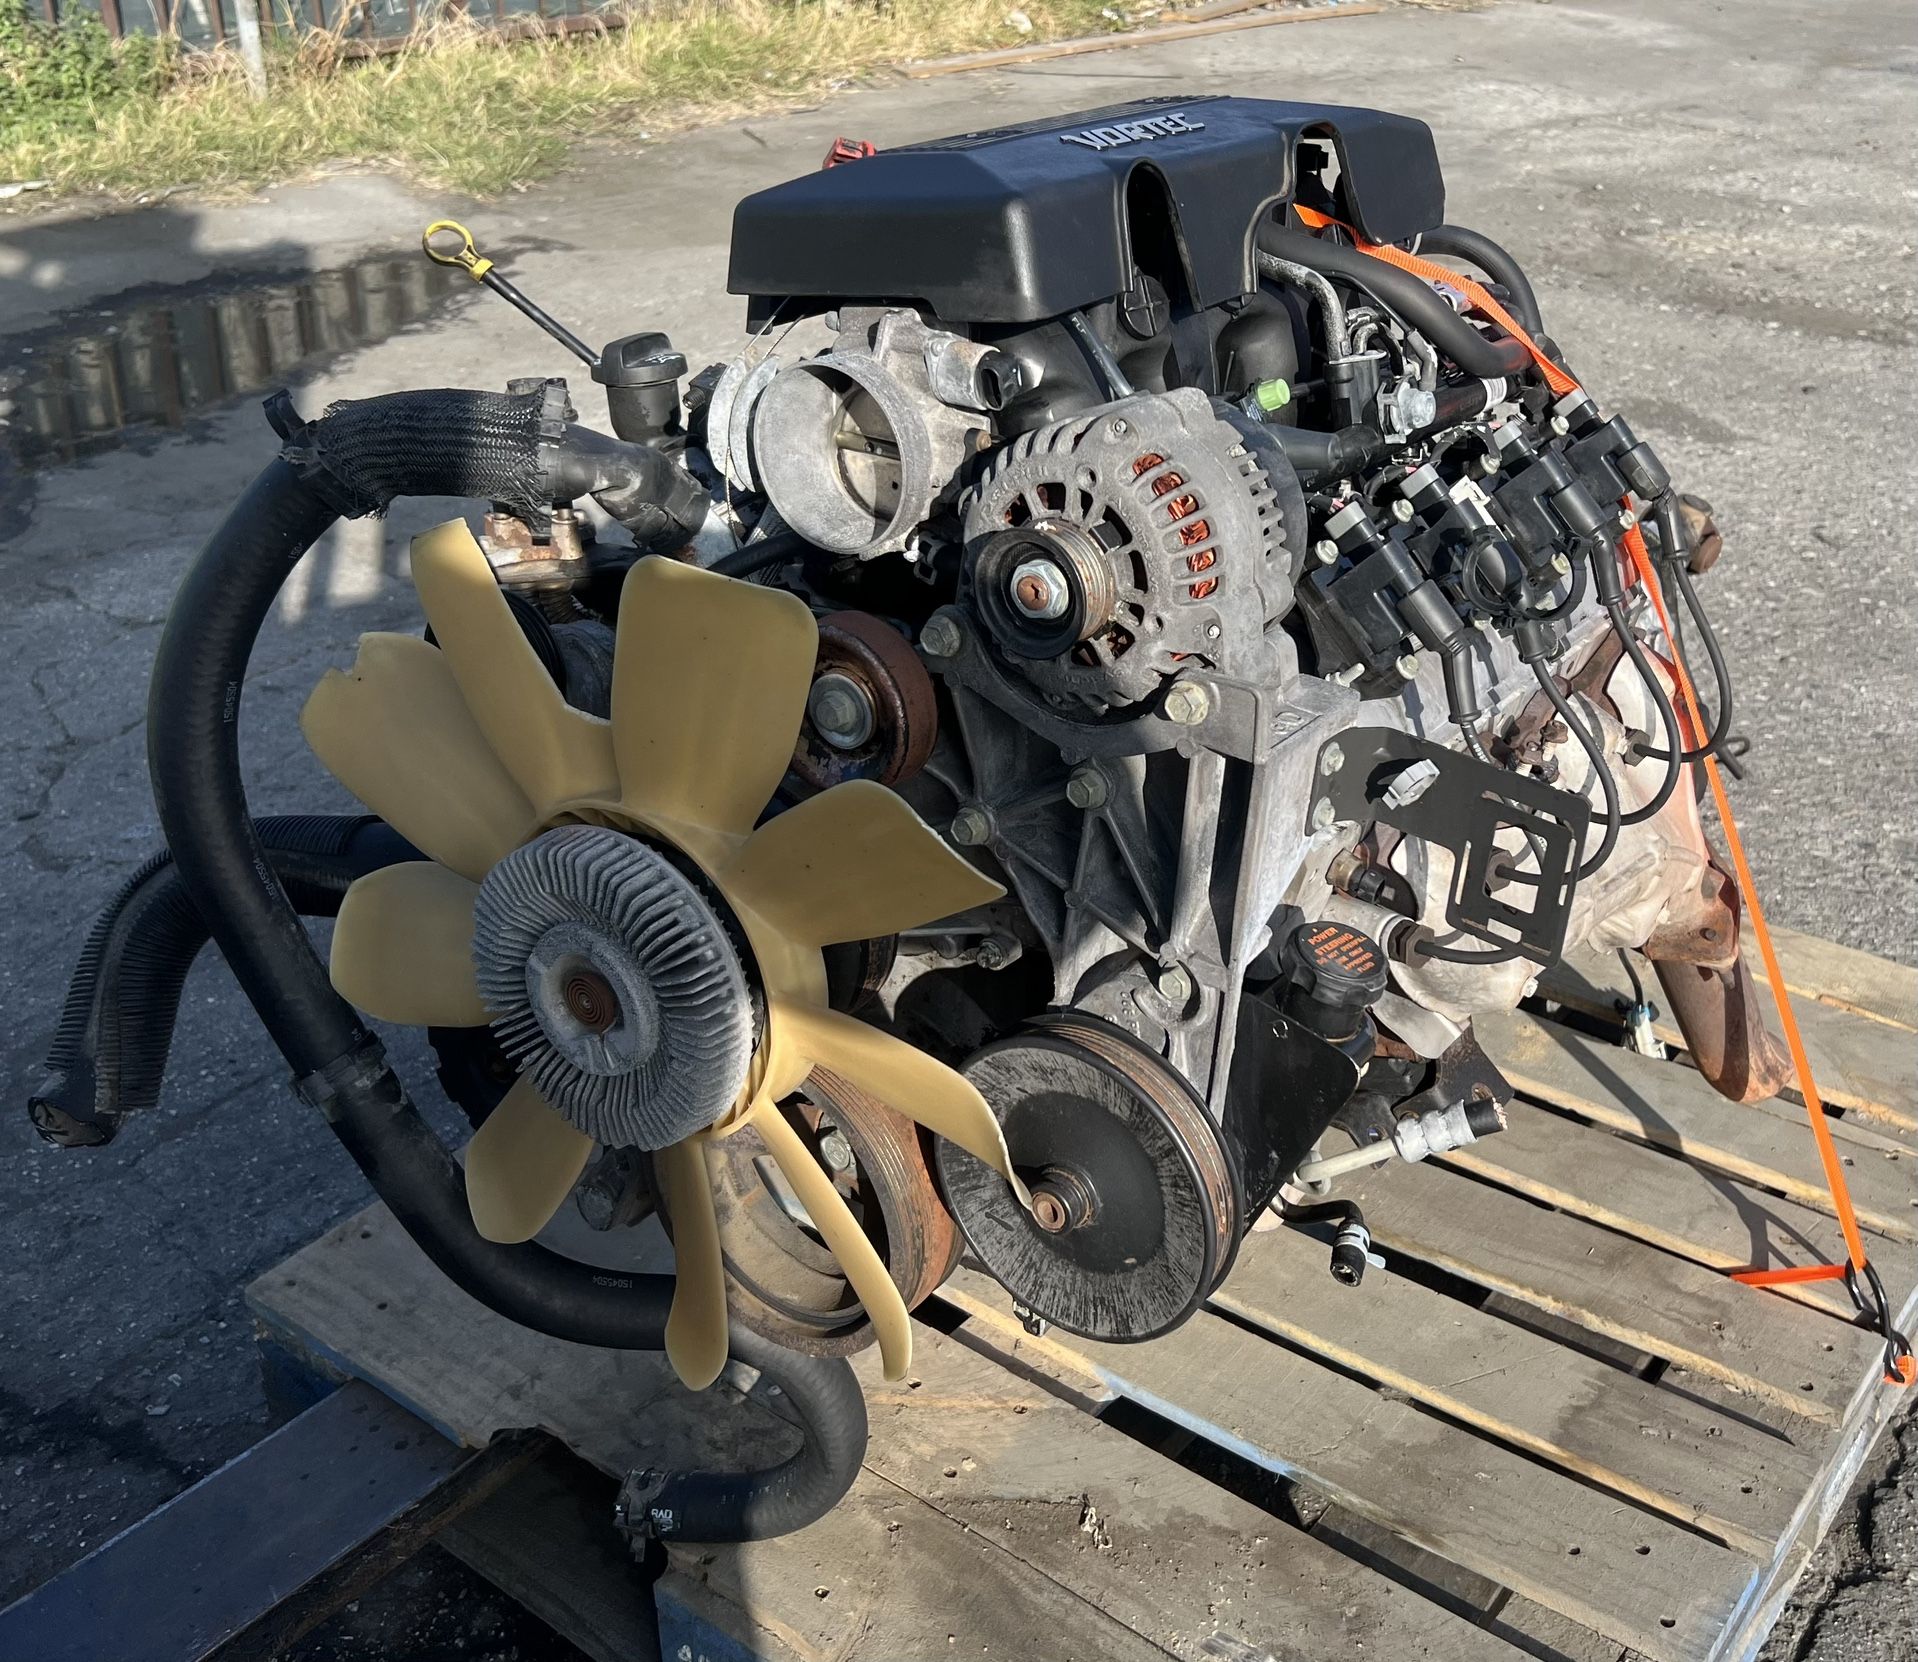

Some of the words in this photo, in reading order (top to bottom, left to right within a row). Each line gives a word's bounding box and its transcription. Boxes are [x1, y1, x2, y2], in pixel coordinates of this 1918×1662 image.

[1060, 112, 1206, 151] VORTEC
[1308, 927, 1338, 945] POWER
[1315, 933, 1353, 955] STEERING
[1328, 950, 1340, 959] NOT
[1341, 935, 1367, 952] OVERFILL
[1349, 947, 1364, 957] ONLY
[1357, 961, 1375, 973] FLUID
[651, 1508, 673, 1519] RAD
